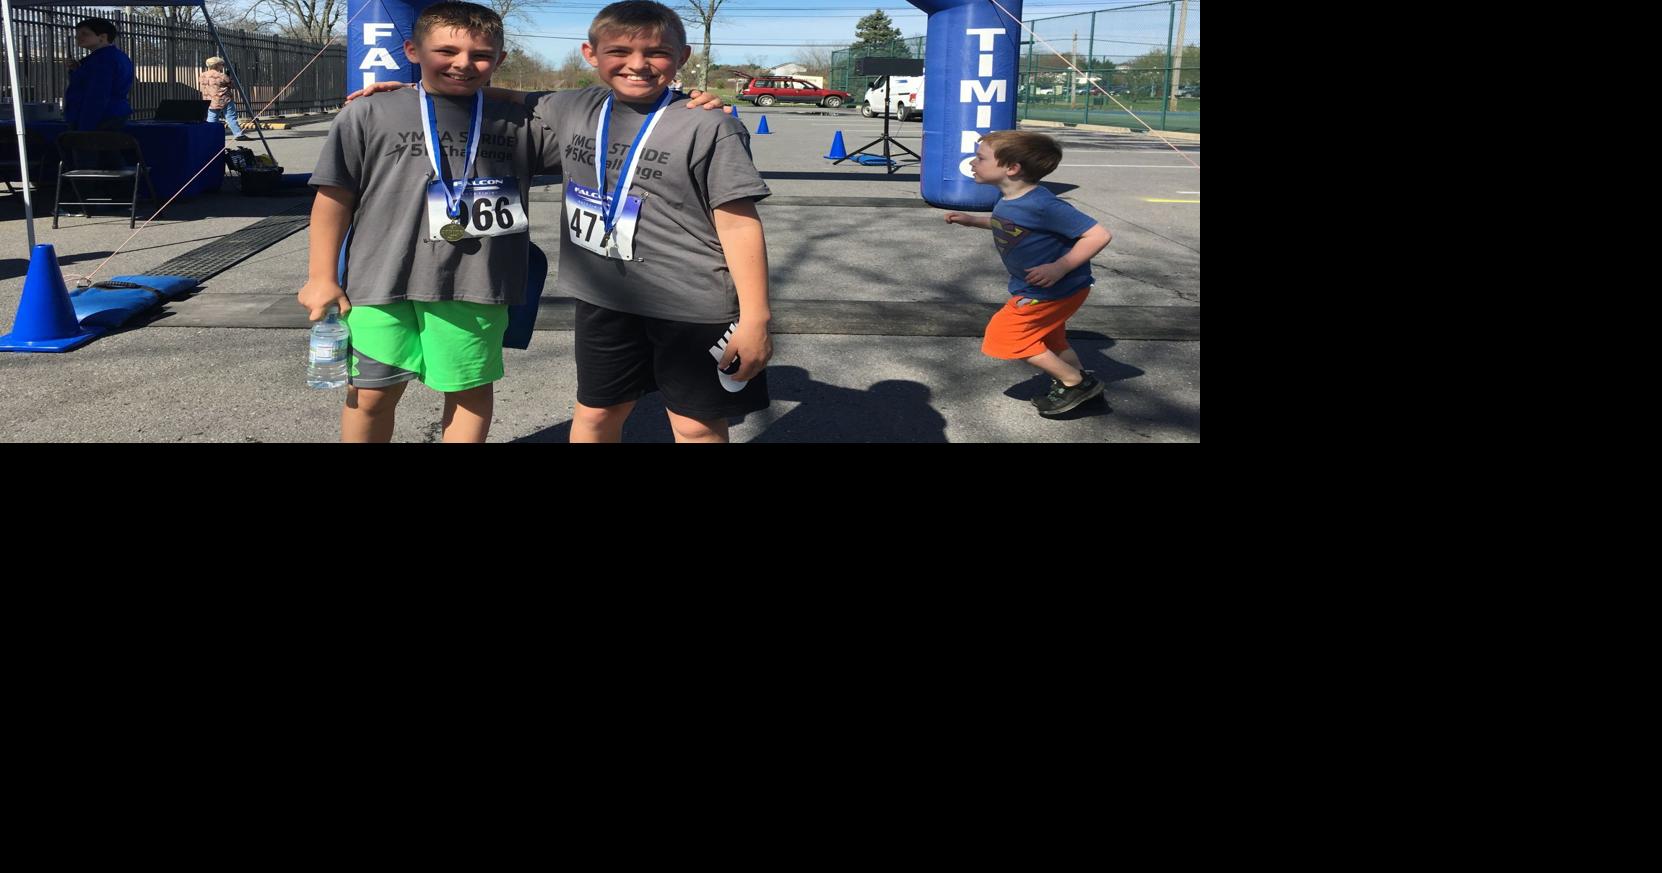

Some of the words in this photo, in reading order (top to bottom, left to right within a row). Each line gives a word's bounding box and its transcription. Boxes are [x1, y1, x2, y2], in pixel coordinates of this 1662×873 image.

[398, 131, 454, 143] YMA
[459, 131, 515, 147] SRIDE
[572, 134, 596, 150] YMC
[608, 143, 671, 164] STIDE
